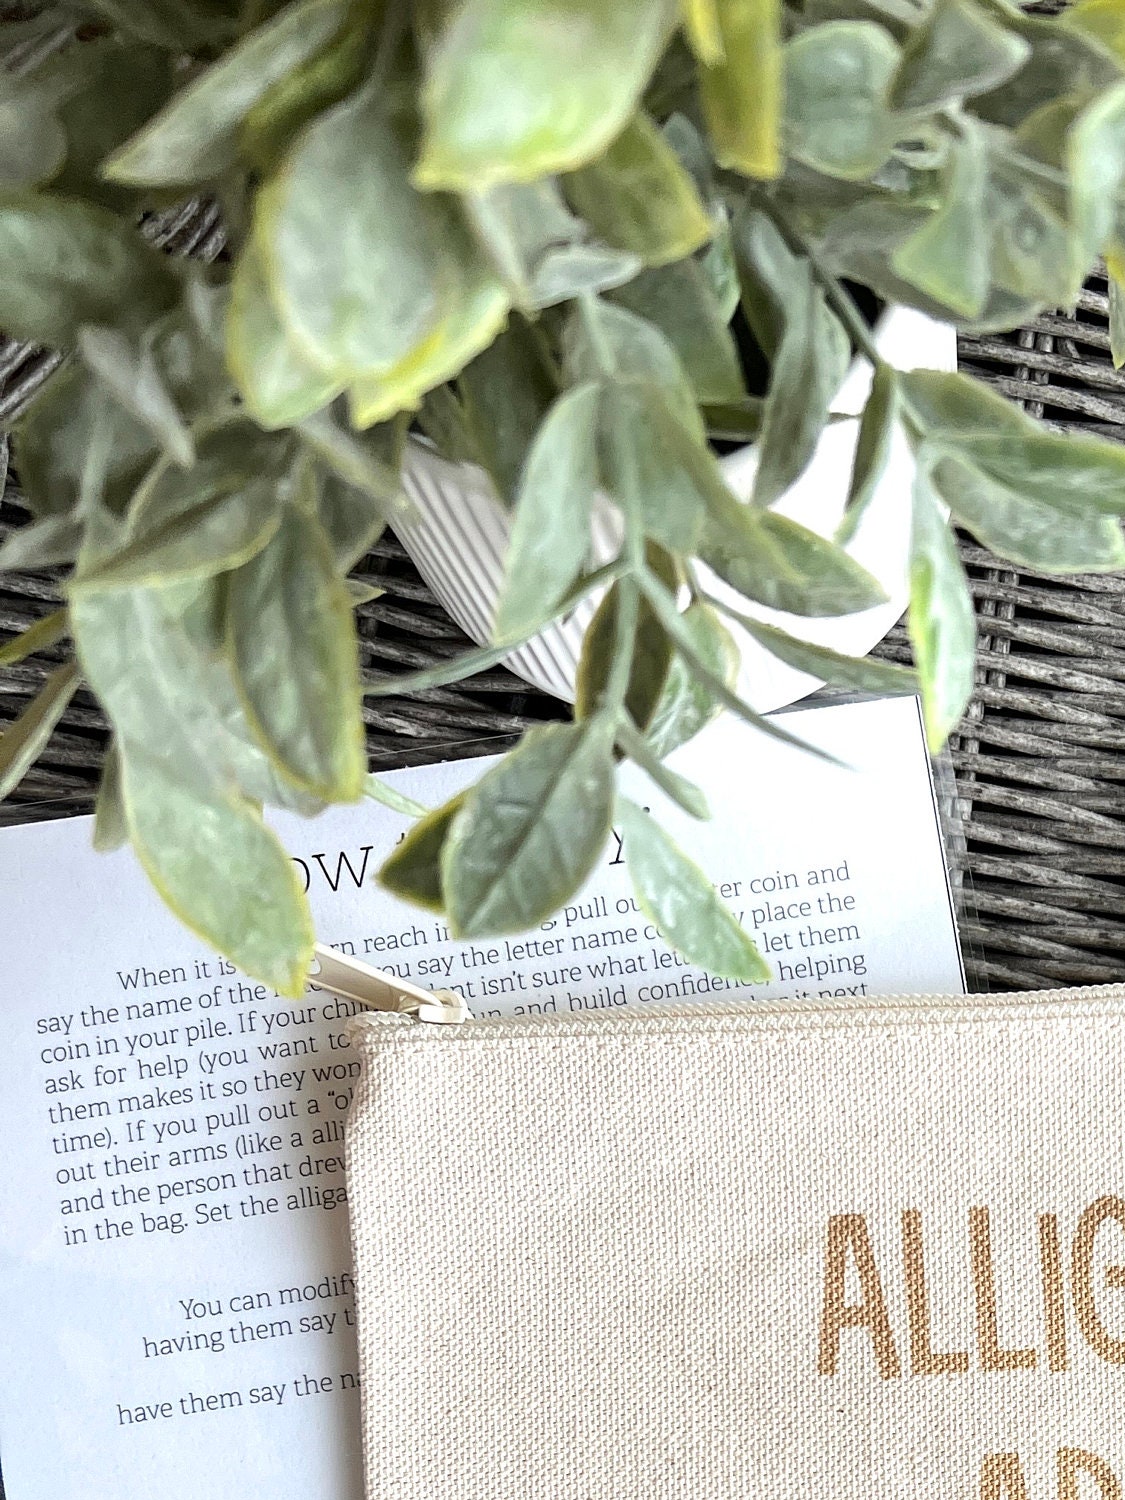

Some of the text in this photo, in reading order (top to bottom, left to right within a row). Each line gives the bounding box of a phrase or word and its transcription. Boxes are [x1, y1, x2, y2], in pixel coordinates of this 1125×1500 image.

[116, 967, 187, 990] When
[194, 960, 212, 979] it
[218, 956, 236, 976] is
[363, 926, 428, 953] reach
[564, 896, 608, 927] pull
[750, 871, 799, 893] coin
[808, 860, 850, 885] and
[37, 1015, 74, 1035] say
[80, 1005, 119, 1027] the
[126, 997, 192, 1020] name
[199, 986, 222, 1008] of
[228, 983, 266, 1004] the
[418, 956, 454, 976] say
[460, 947, 499, 968] the
[505, 939, 564, 961] letter
[571, 928, 637, 951] name
[752, 902, 811, 929] place
[817, 893, 855, 914] the
[41, 1040, 91, 1064] coin
[96, 1036, 120, 1055] in
[124, 1029, 179, 1056] your
[185, 1018, 232, 1047] pile.
[237, 1011, 257, 1033] If
[262, 1008, 316, 1034] your
[481, 971, 527, 995] isn't
[532, 967, 582, 988] sure
[586, 955, 647, 978] what
[763, 932, 793, 953] let
[799, 925, 860, 947] them
[45, 1070, 85, 1094] ask
[95, 1065, 126, 1086] for
[137, 1055, 188, 1079] help
[199, 1049, 248, 1074] (you
[257, 1036, 318, 1060] want
[567, 984, 628, 1011] build
[777, 954, 867, 981] helping
[48, 1101, 111, 1124] them
[118, 1087, 193, 1113] makes
[200, 1081, 217, 1100] it
[222, 1080, 247, 1097] so
[254, 1070, 306, 1092] they
[53, 1127, 118, 1154] time).
[126, 1120, 146, 1142] If
[153, 1118, 197, 1143] you
[205, 1104, 251, 1135] pull
[259, 1101, 298, 1121] out
[307, 1099, 320, 1114] a
[56, 1163, 96, 1184] out
[104, 1151, 160, 1177] their
[169, 1144, 227, 1166] arms
[235, 1132, 282, 1159] (like
[291, 1133, 303, 1147] a
[61, 1188, 105, 1215] and
[111, 1184, 150, 1206] the
[157, 1174, 237, 1205] person
[243, 1163, 293, 1185] that
[64, 1226, 88, 1245] in
[94, 1218, 134, 1240] the
[140, 1213, 188, 1234] bag.
[195, 1203, 233, 1224] Set
[240, 1195, 279, 1217] the
[179, 1299, 223, 1320] You
[230, 1293, 272, 1312] can
[142, 1331, 225, 1358] having
[229, 1320, 293, 1343] them
[300, 1313, 336, 1334] say
[116, 1403, 172, 1425] have
[179, 1392, 243, 1415] them
[249, 1384, 286, 1405] say
[293, 1374, 332, 1396] the
